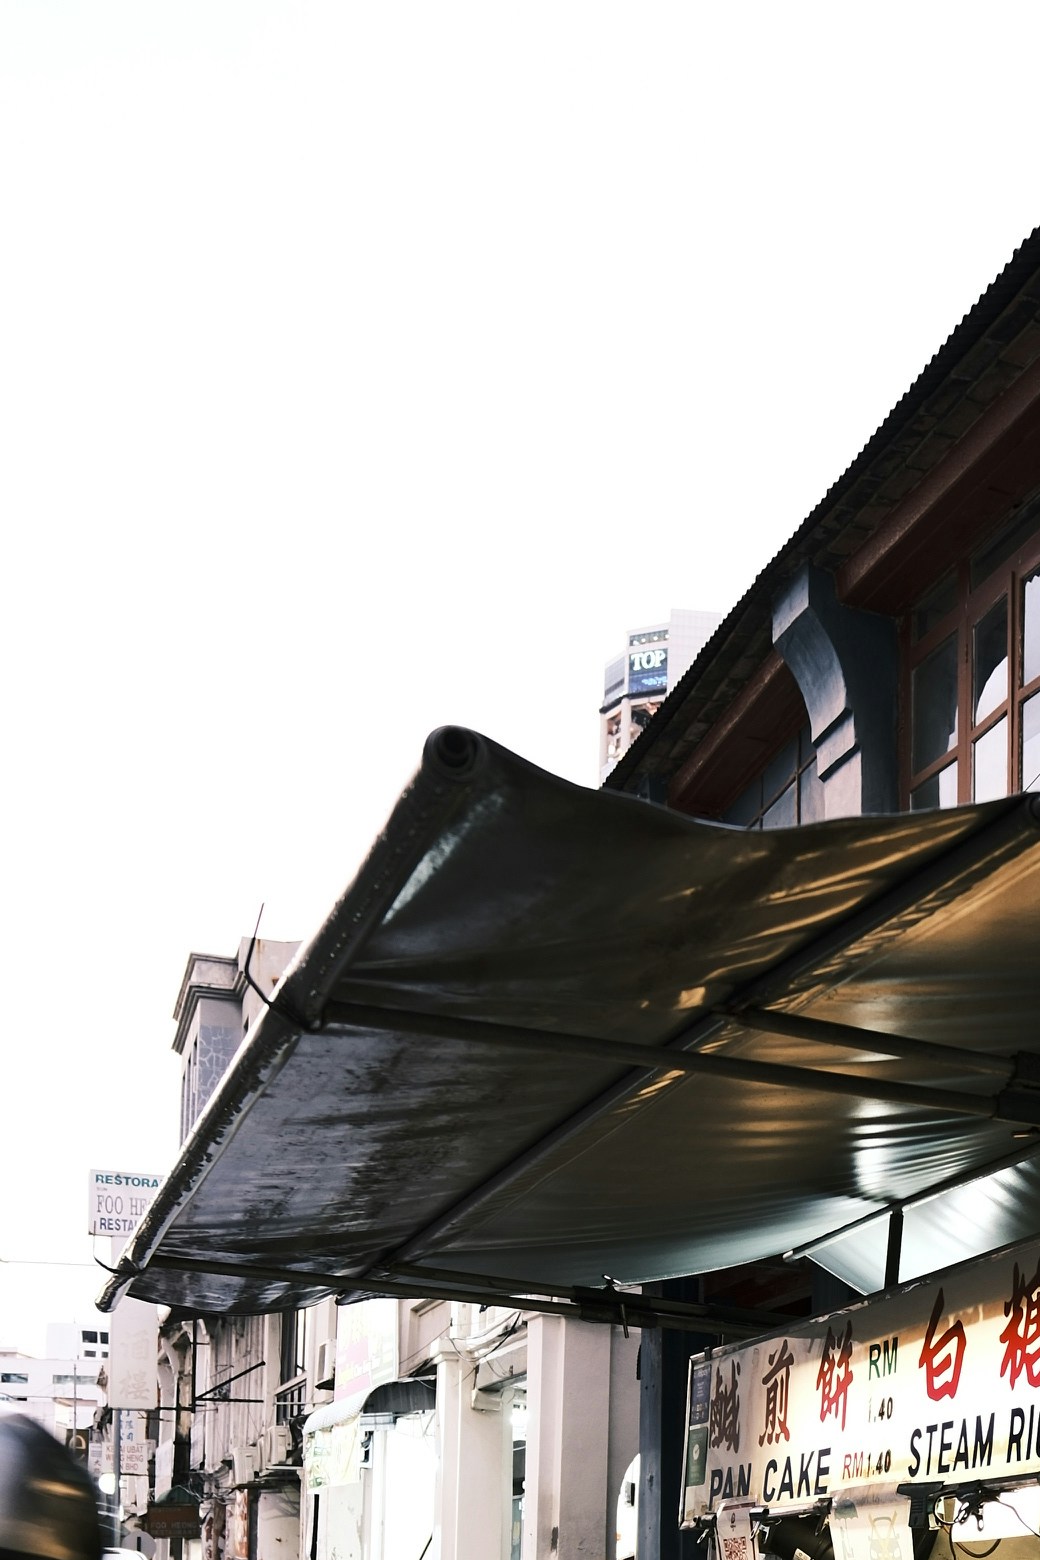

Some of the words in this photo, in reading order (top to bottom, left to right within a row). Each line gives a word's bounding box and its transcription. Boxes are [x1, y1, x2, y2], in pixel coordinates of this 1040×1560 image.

[631, 650, 666, 671] TOP
[96, 1174, 161, 1188] RESTORA
[97, 1195, 123, 1214] FOO
[100, 1217, 137, 1231] RESTA
[868, 1337, 898, 1380] RM
[908, 1413, 995, 1478] STEAM
[709, 1463, 751, 1508] PAN
[763, 1447, 831, 1502] CAKE
